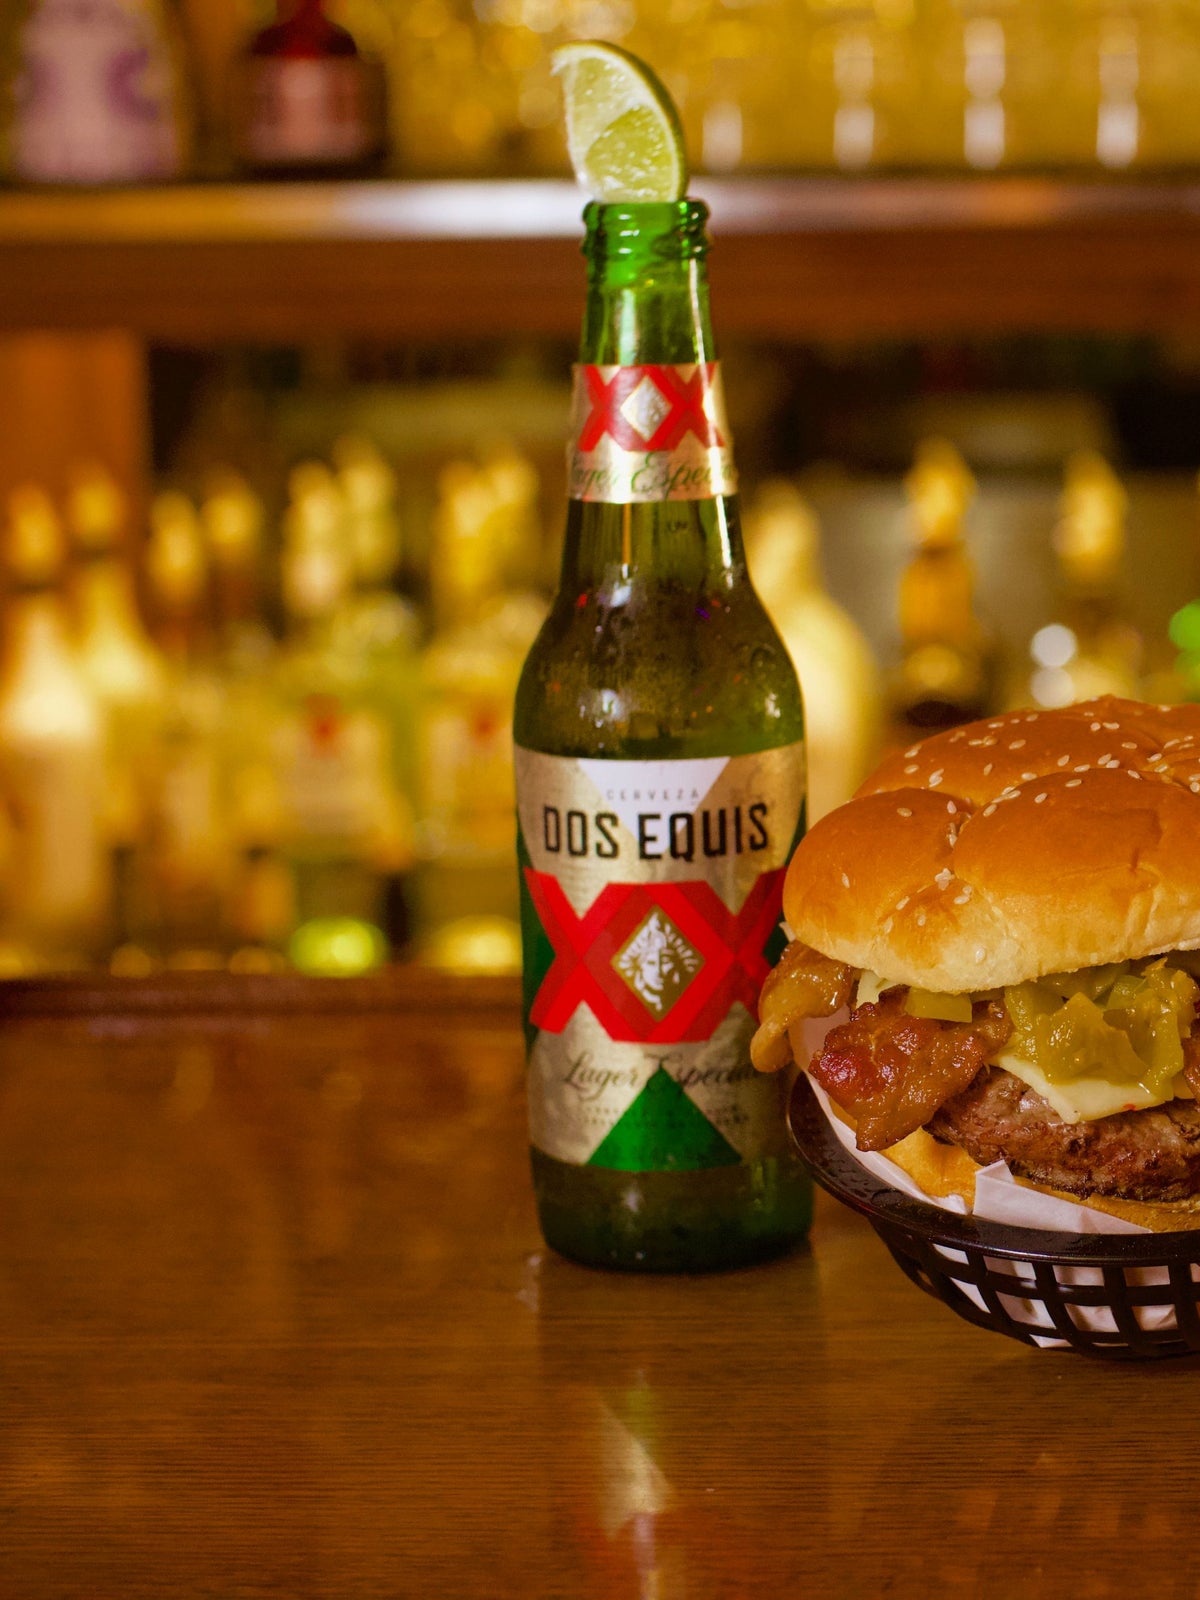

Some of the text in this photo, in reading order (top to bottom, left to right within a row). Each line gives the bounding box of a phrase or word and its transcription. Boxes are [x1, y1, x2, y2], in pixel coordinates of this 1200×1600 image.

[606, 787, 700, 802] CERVEZA
[543, 802, 769, 862] DOS EQUIS
[562, 1052, 639, 1101] Lager
